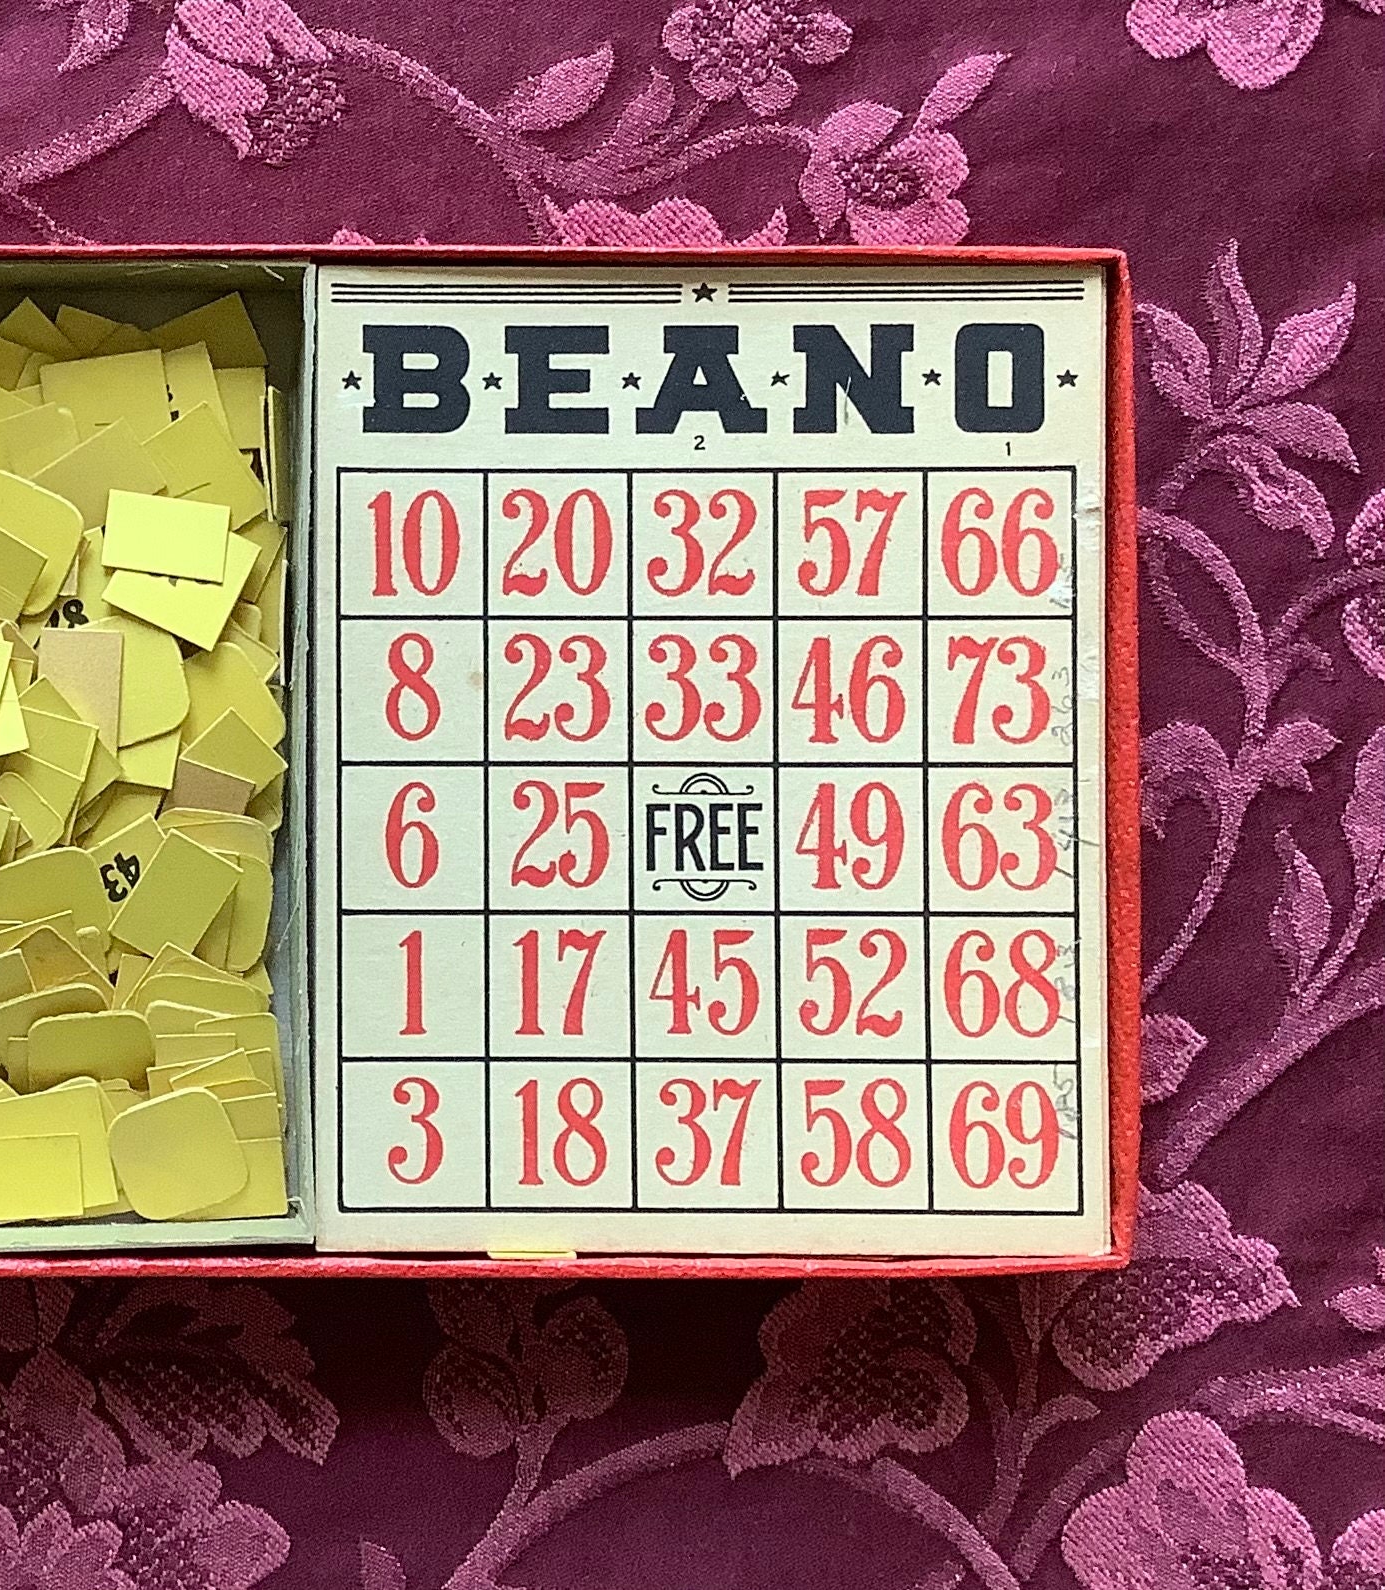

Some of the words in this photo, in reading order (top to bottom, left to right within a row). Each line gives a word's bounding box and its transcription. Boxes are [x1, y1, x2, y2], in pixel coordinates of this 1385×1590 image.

[363, 323, 1045, 434] BEANO
[694, 434, 706, 451] 2
[1004, 441, 1012, 456] 1
[368, 489, 461, 597] 10
[501, 488, 613, 597] 20
[646, 488, 757, 597] 32
[796, 488, 907, 597] 57
[940, 487, 1060, 597] 66
[385, 633, 442, 741] 8
[503, 633, 611, 742] 23
[644, 634, 762, 742] 33
[791, 635, 906, 744] 46
[946, 635, 1051, 746] 73
[99, 852, 141, 903] 43
[384, 782, 439, 888] 6
[510, 780, 610, 889] 25
[645, 802, 764, 872] FREE
[795, 781, 906, 890] 49
[940, 782, 1058, 891] 63
[398, 930, 428, 1036] 1
[512, 929, 607, 1036] 17
[649, 929, 761, 1036] 45
[799, 928, 908, 1038] 52
[943, 929, 1061, 1038] 68
[387, 1077, 444, 1185] 3
[515, 1077, 608, 1187] 18
[654, 1078, 761, 1187] 37
[799, 1077, 912, 1188] 58
[948, 1080, 1061, 1190] 69
